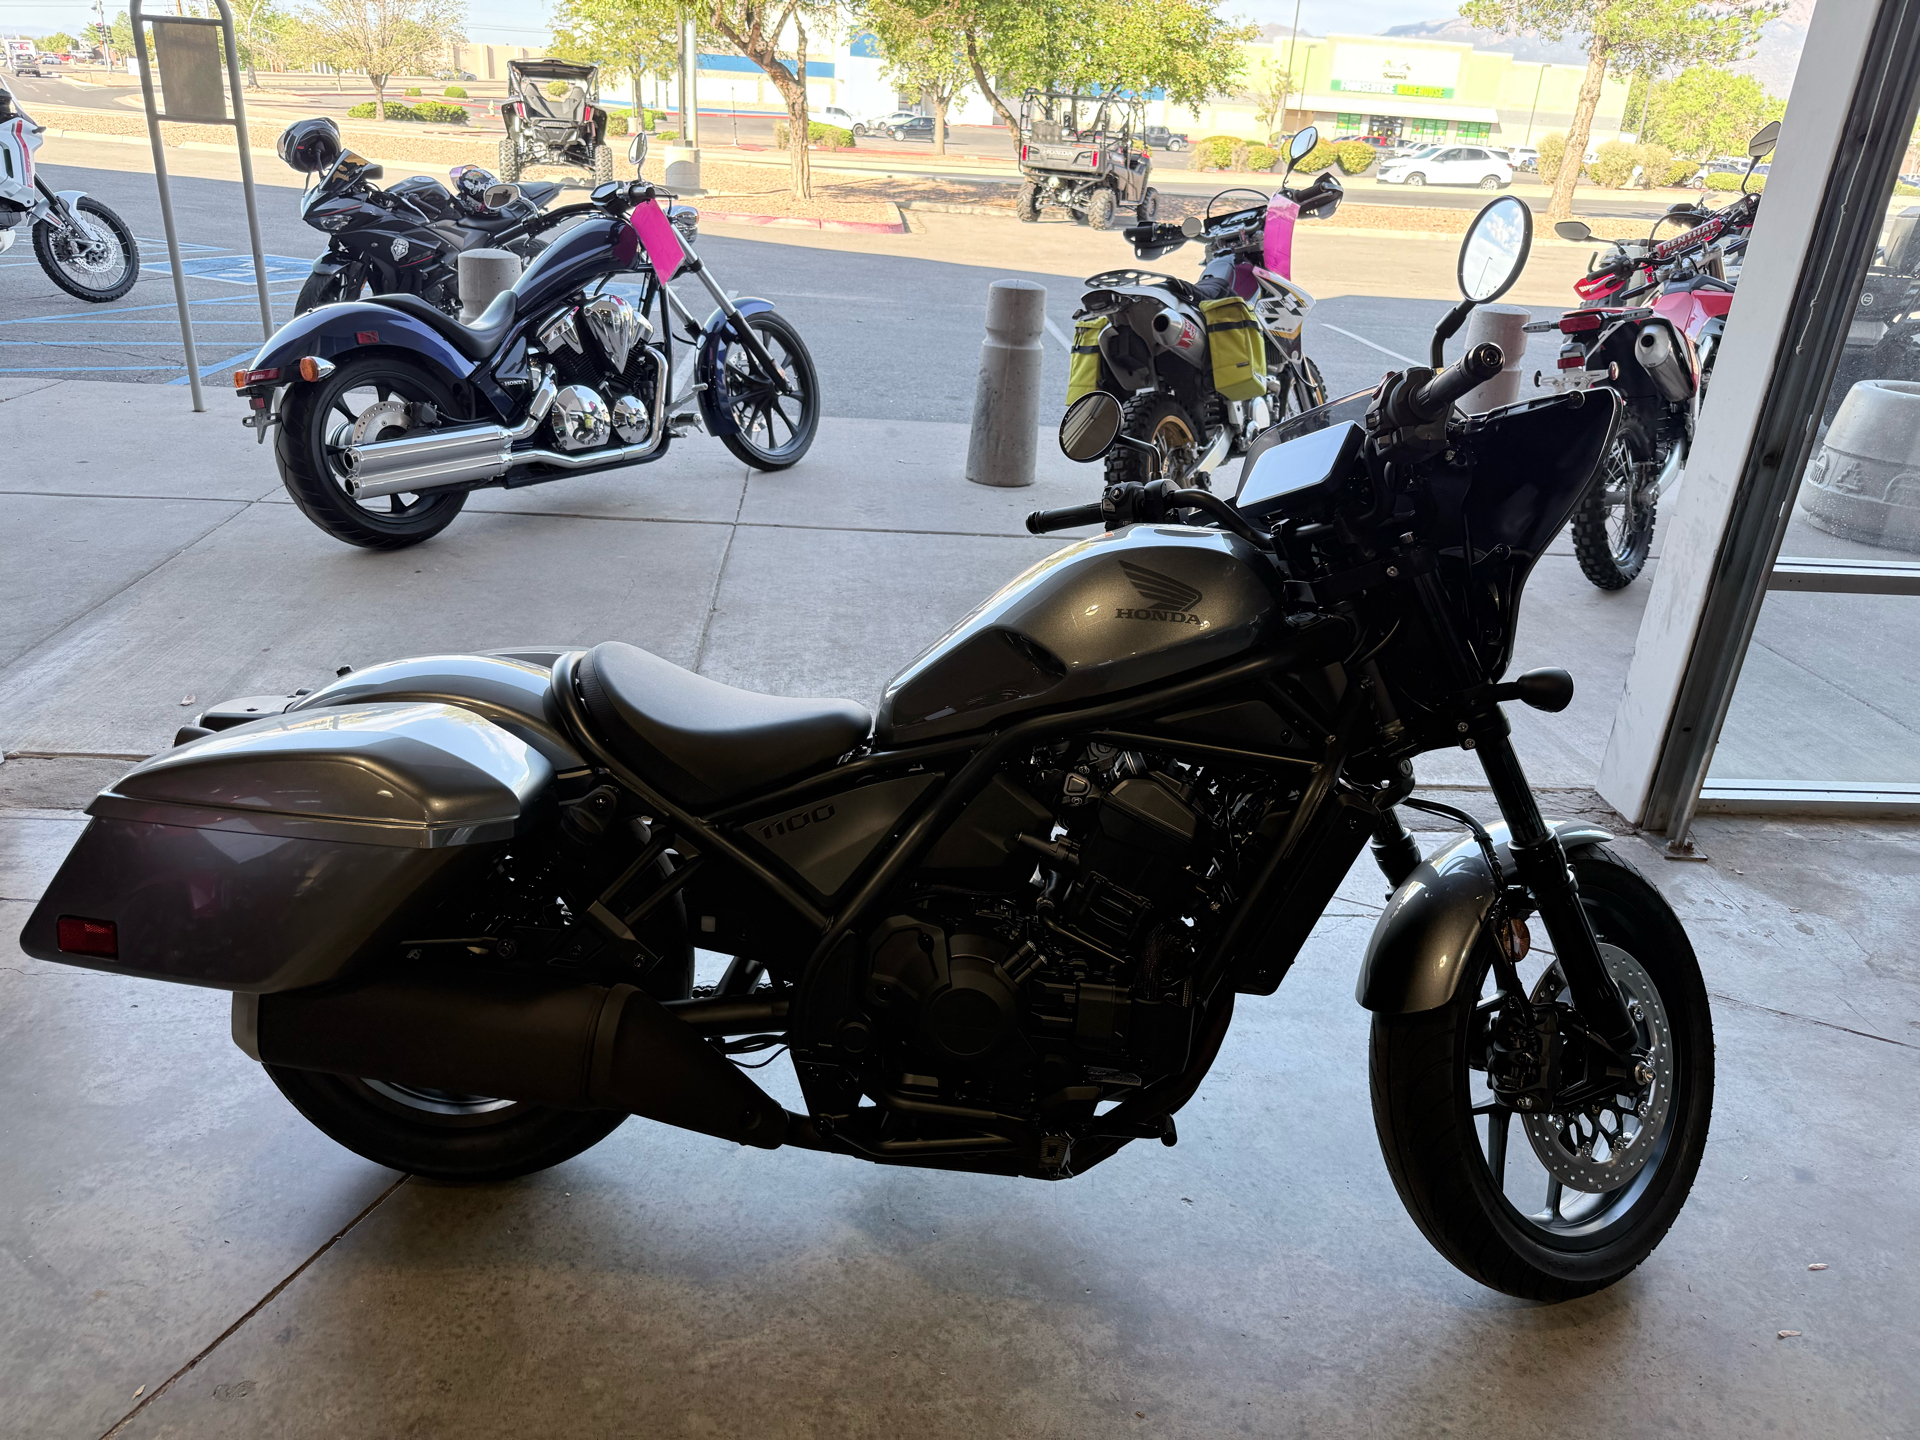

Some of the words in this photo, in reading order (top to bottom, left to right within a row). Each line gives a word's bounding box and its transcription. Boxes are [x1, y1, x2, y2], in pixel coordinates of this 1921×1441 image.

[1397, 84, 1445, 98] WAREHOUSE
[1043, 149, 1074, 157] HONDA
[1662, 222, 1717, 251] RENTHAL
[1115, 608, 1202, 626] HONDA
[758, 803, 836, 840] 1100
